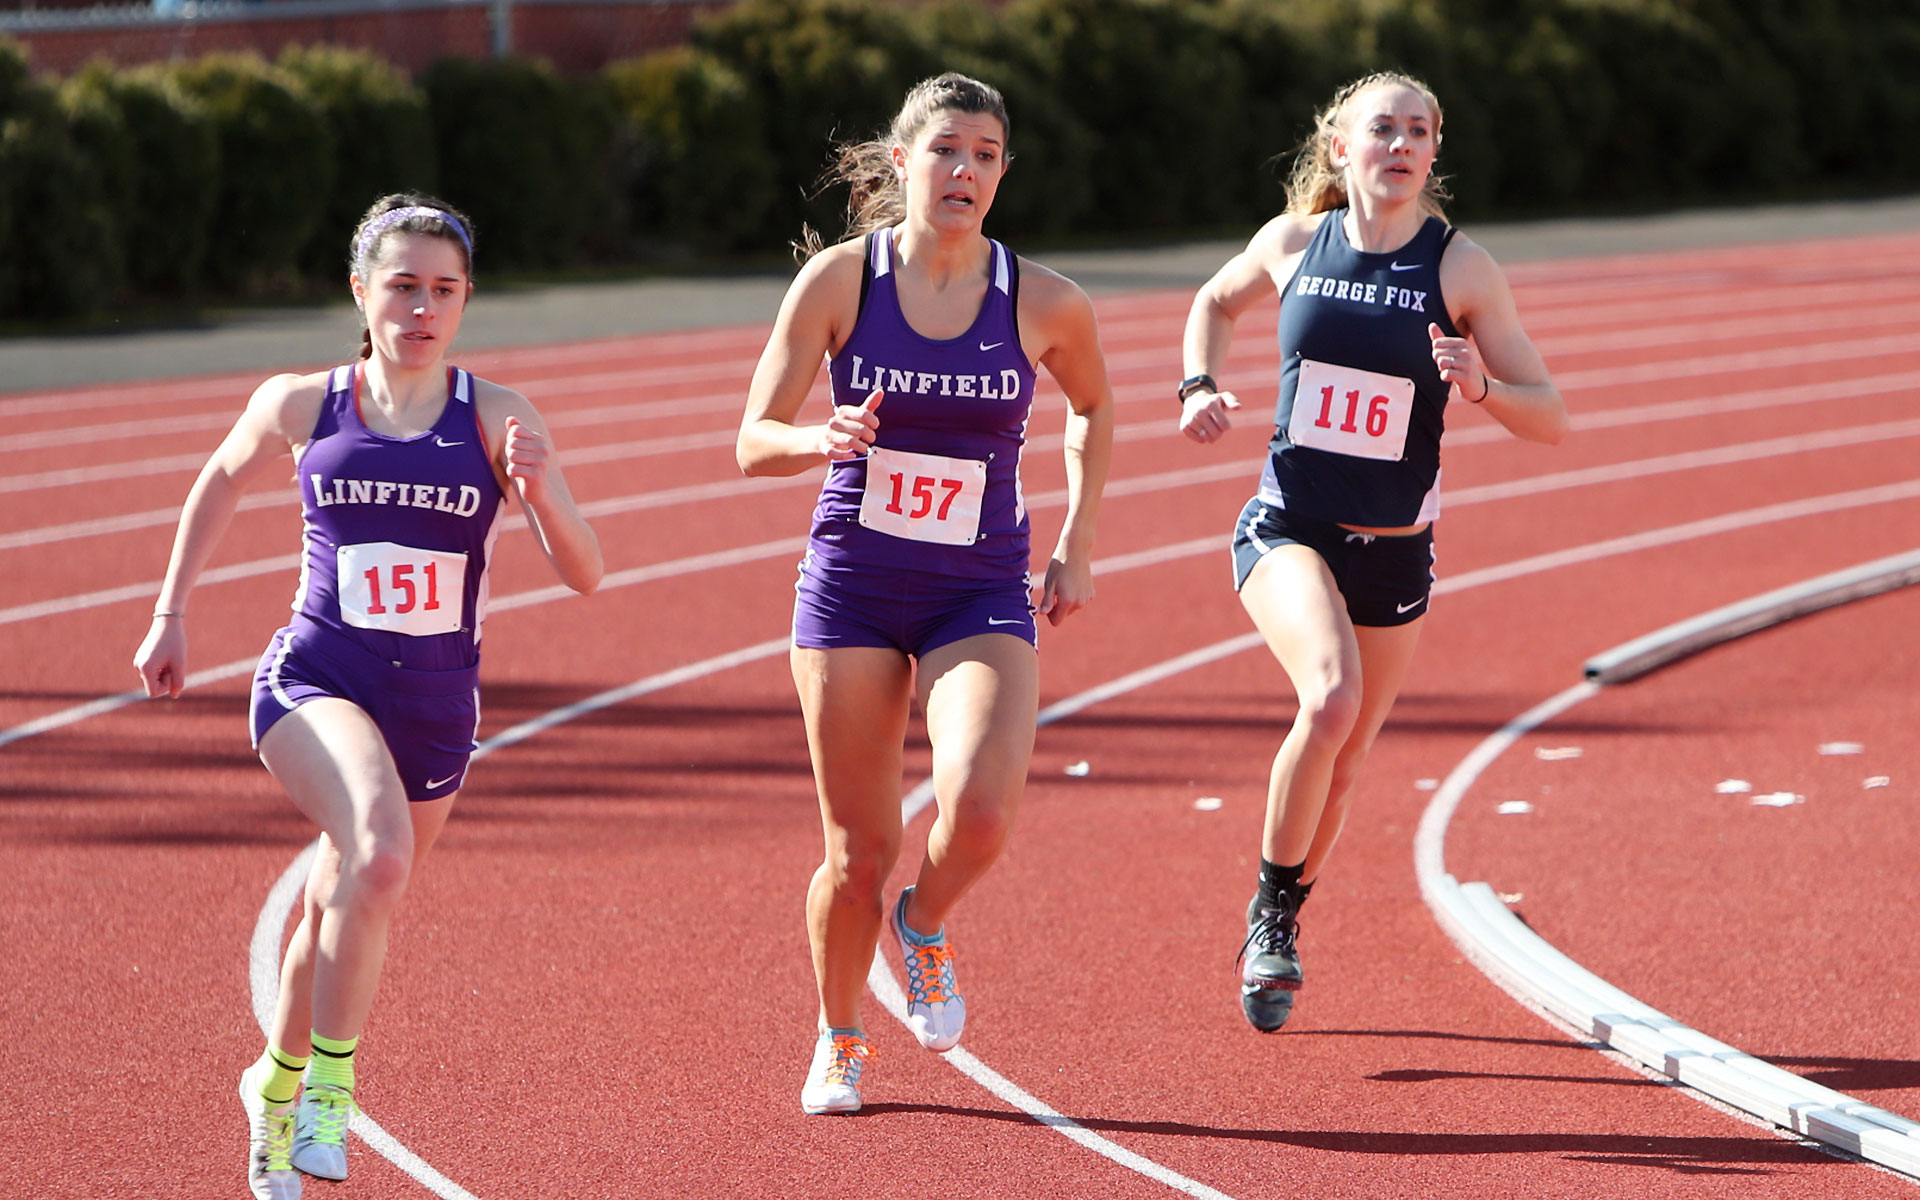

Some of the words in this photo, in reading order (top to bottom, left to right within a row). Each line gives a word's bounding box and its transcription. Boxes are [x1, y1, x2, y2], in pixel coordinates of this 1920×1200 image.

[1297, 276, 1377, 304] GEORGE
[1384, 286, 1427, 312] FOX
[850, 355, 1020, 400] LINFIELD
[1314, 385, 1390, 437] 116
[310, 474, 481, 517] LINFIELD
[885, 472, 963, 521] 157
[364, 562, 439, 615] 151
